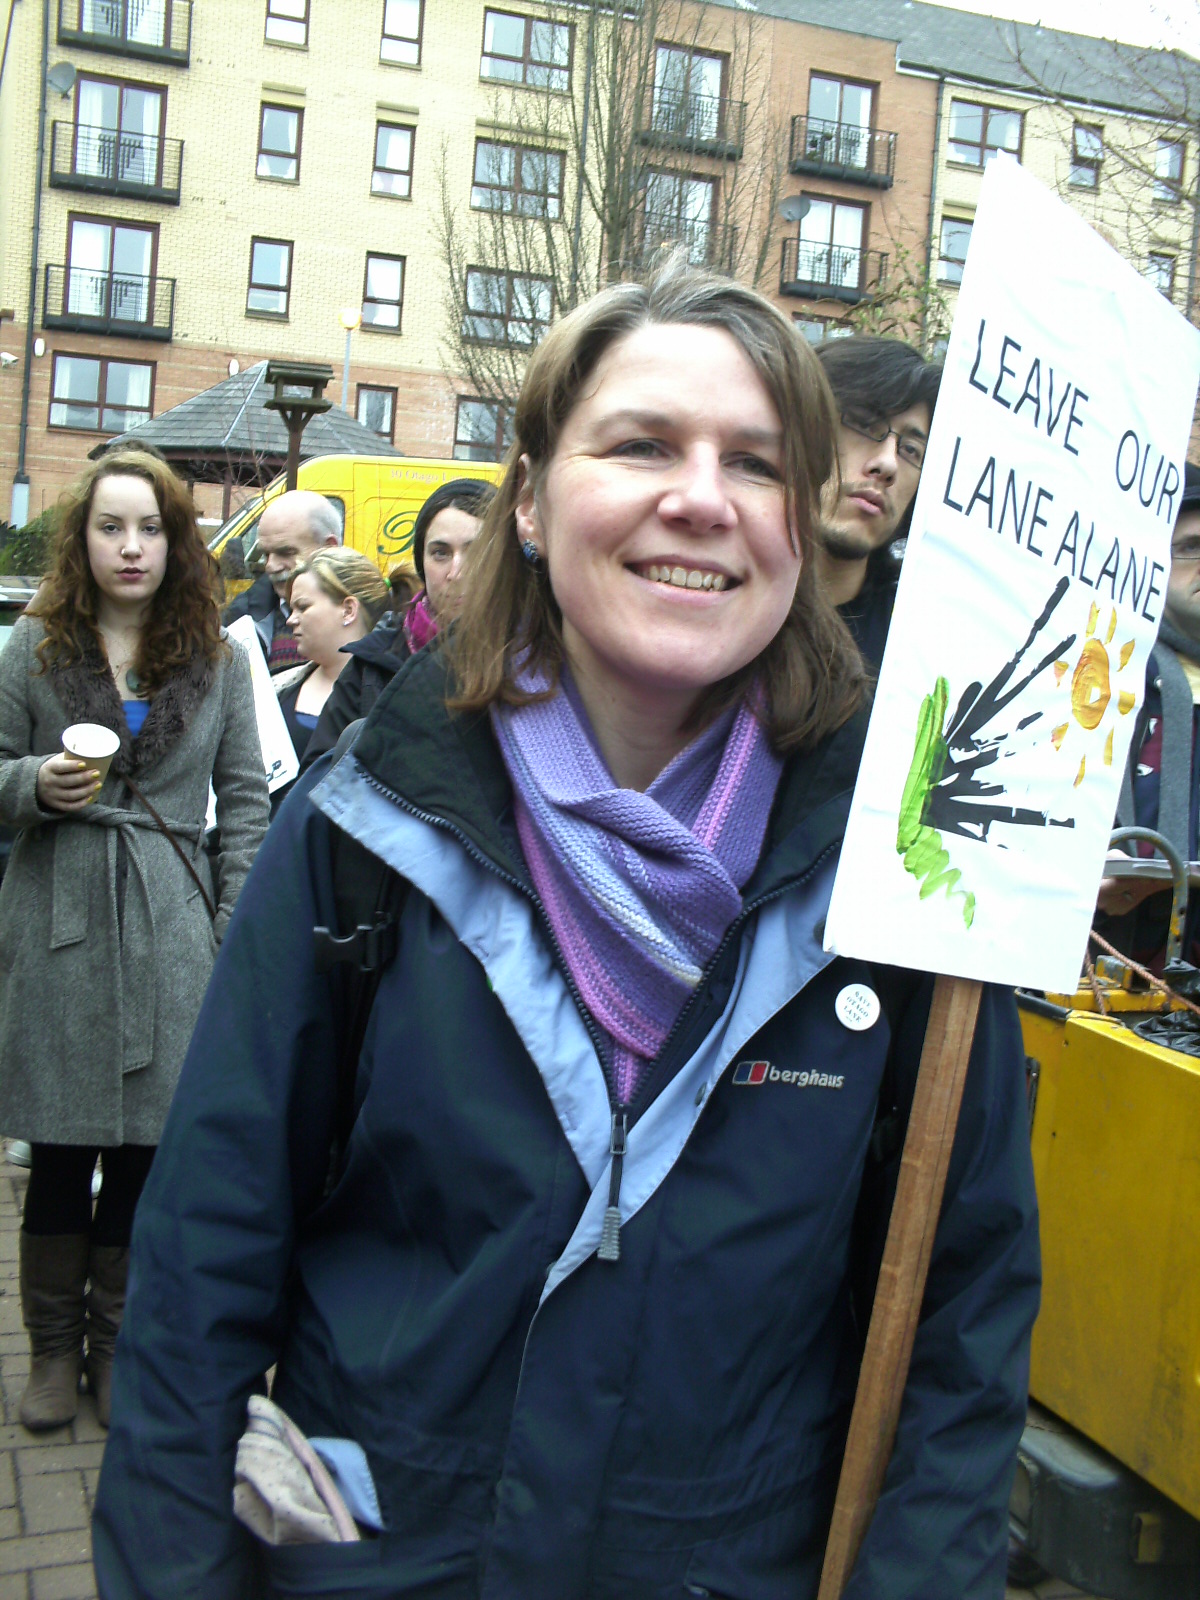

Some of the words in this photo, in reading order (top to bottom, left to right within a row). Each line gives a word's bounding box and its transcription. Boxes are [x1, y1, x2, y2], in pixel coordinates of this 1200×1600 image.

[969, 318, 1089, 456] LEAVE
[1115, 430, 1180, 524] OUR
[405, 471, 438, 484] Otago
[943, 437, 1054, 557] LANE
[1054, 511, 1165, 623] ALANE
[846, 996, 869, 1017] OTAGO
[769, 1065, 845, 1088] berghaus
